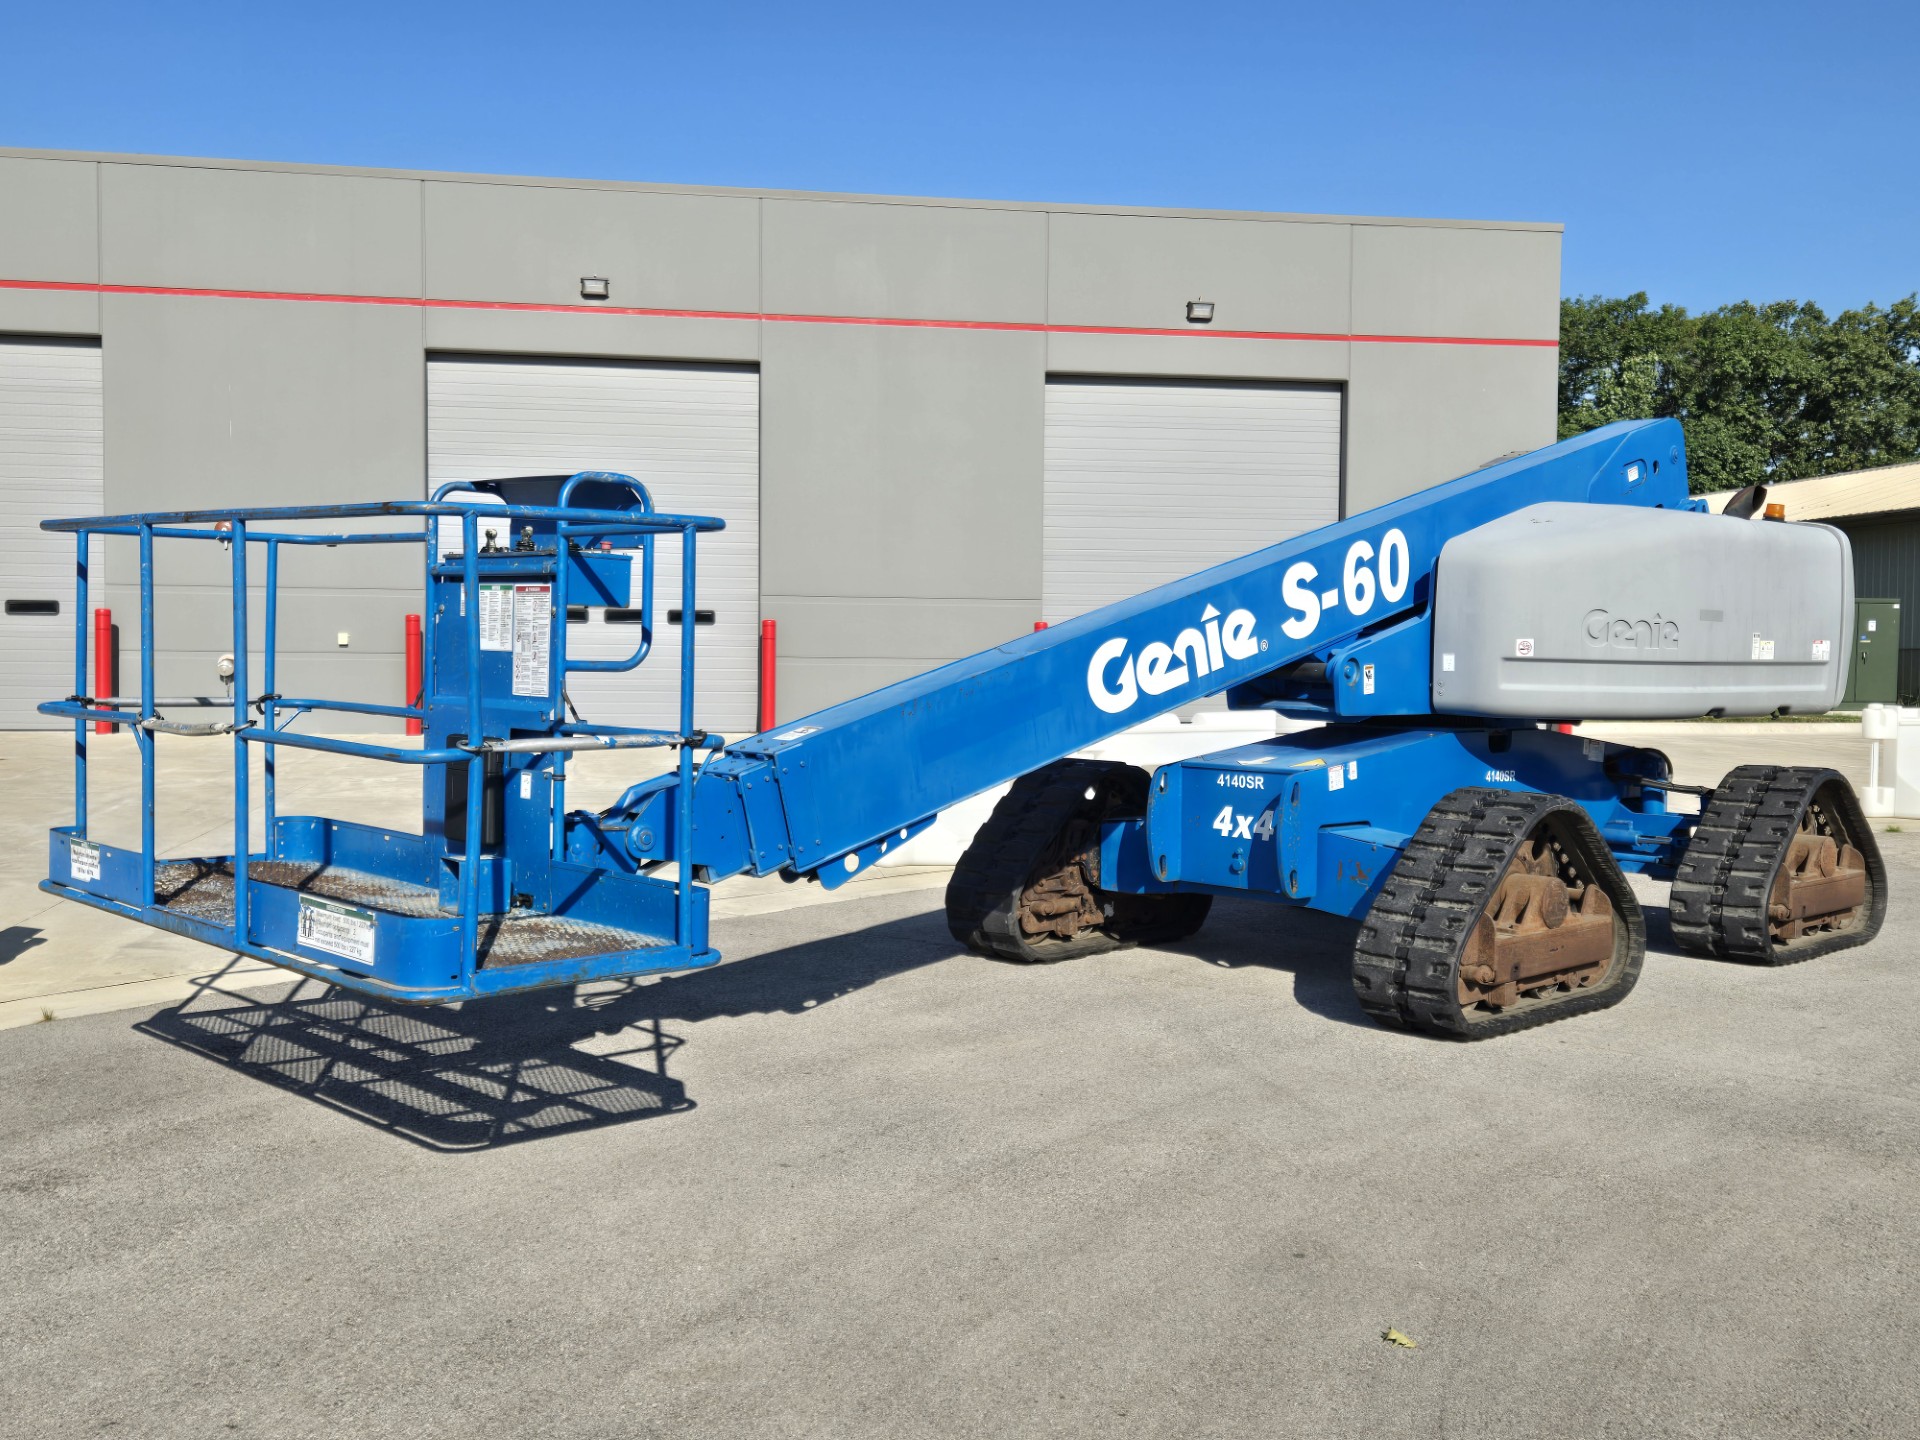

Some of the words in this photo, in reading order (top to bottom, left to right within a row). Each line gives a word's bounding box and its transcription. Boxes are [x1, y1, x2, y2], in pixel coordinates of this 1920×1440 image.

[1281, 528, 1409, 640] S-60
[1581, 608, 1679, 649] Genie
[1217, 774, 1265, 790] 4140SR
[1485, 770, 1516, 782] 4140SR
[1212, 806, 1275, 842] 4x4
